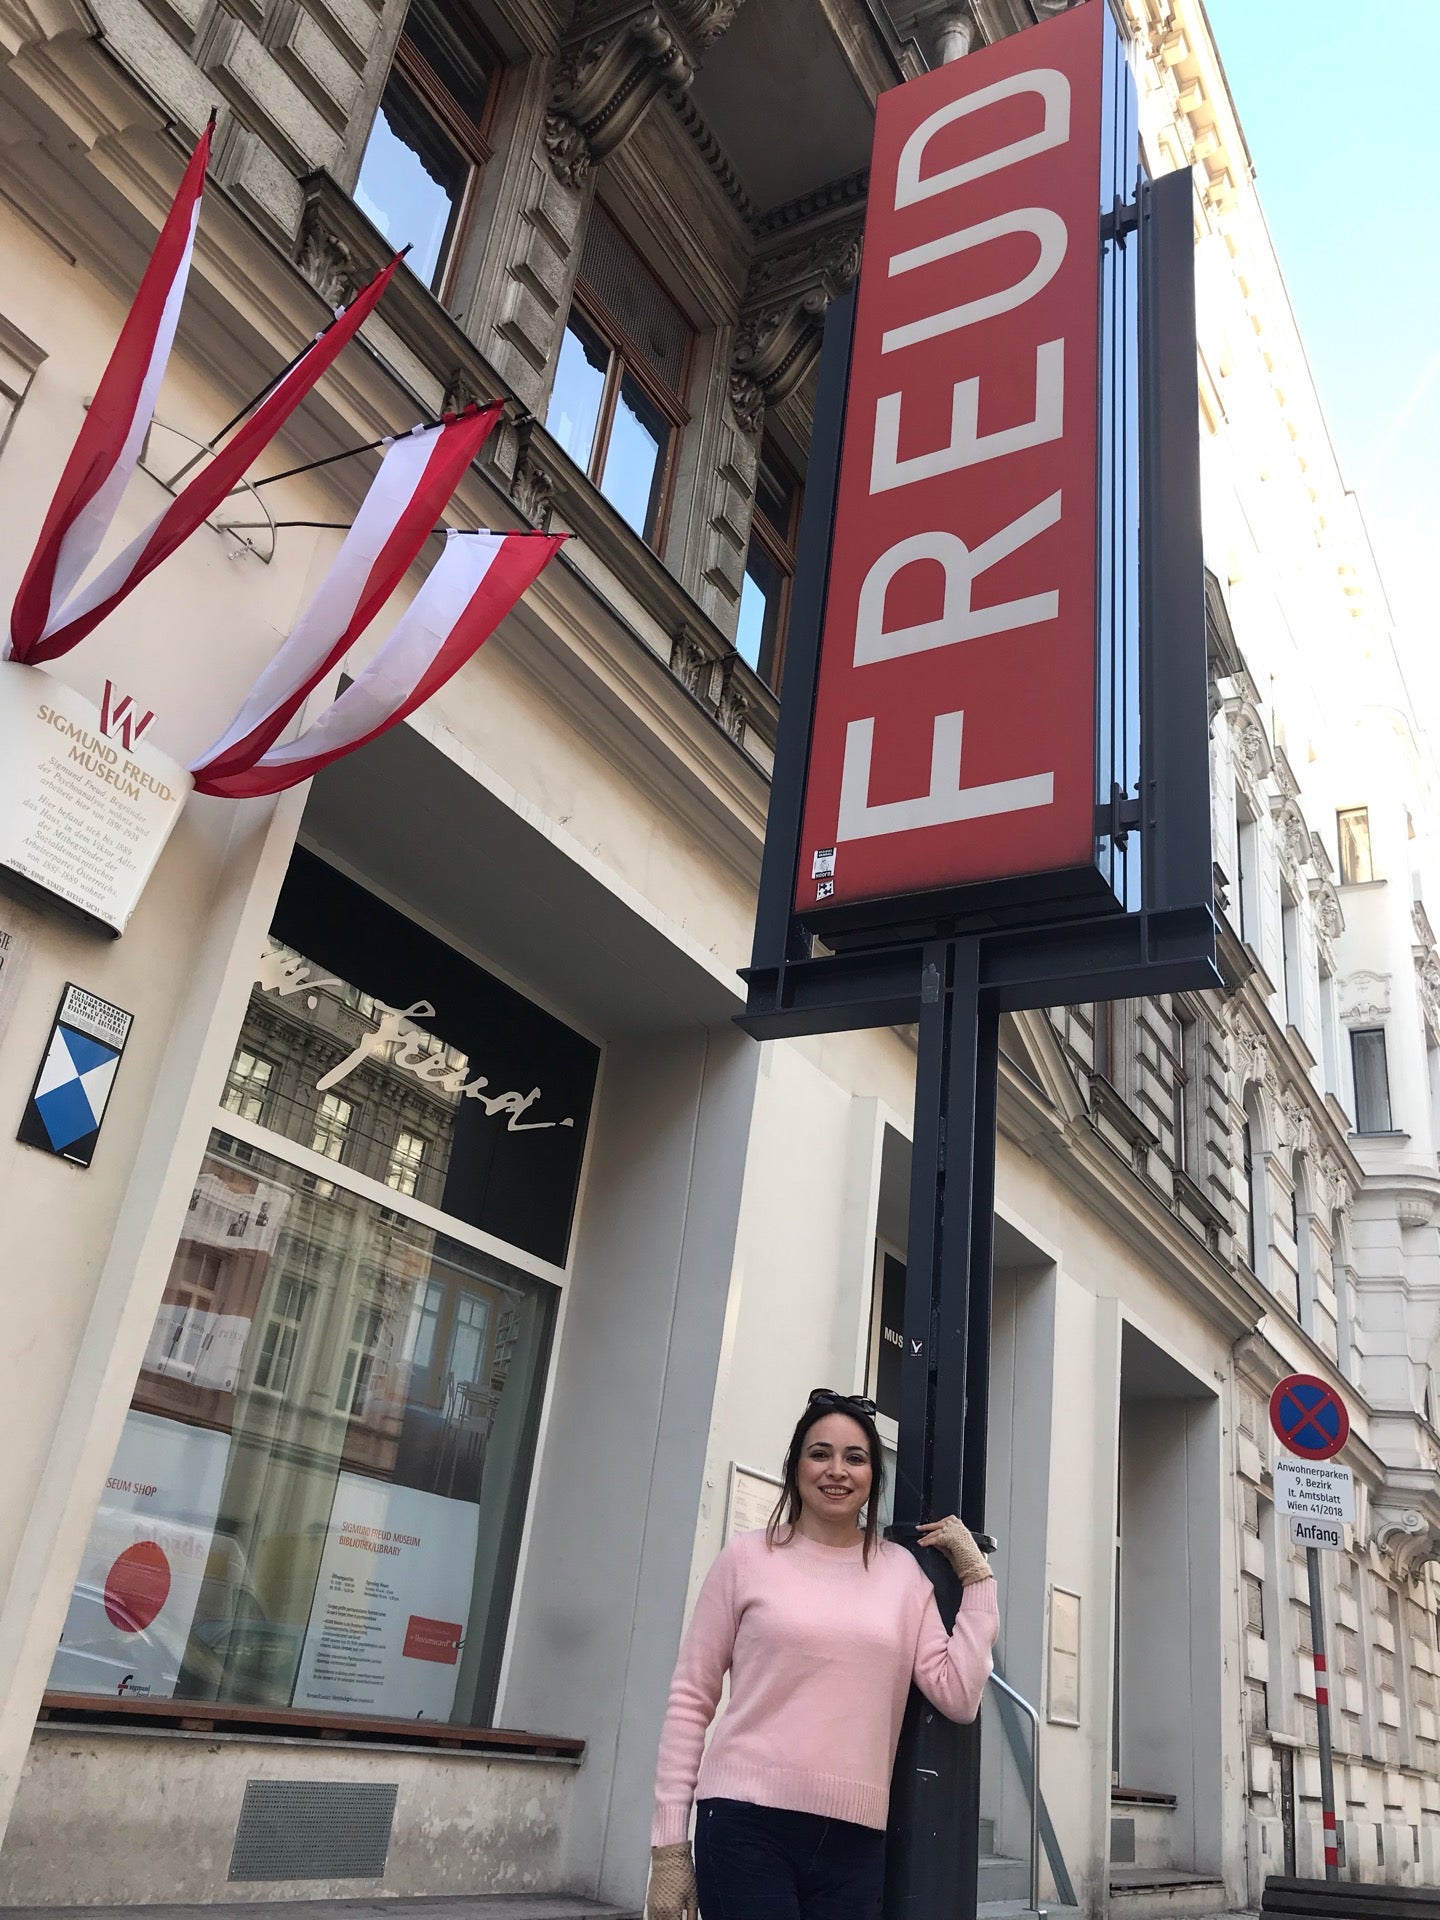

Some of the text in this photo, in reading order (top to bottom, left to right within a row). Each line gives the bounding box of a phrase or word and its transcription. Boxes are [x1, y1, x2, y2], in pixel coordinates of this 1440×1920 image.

[836, 68, 1071, 843] FREUD
[37, 704, 177, 802] SIGMUND FREUD-
[48, 756, 84, 782] Sigmund
[68, 746, 140, 801] MUSEUM
[38, 763, 51, 775] der
[135, 825, 151, 837] und
[40, 777, 74, 801] arbeitete
[75, 798, 90, 811] hier
[92, 810, 104, 821] von
[22, 799, 37, 812] das
[64, 823, 73, 833] in
[74, 830, 89, 844] dem
[92, 839, 115, 858] Viktor
[38, 793, 56, 810] Hier
[57, 806, 84, 827] befand
[86, 825, 101, 838] sich
[102, 834, 113, 846] bis
[22, 837, 74, 871] Arbeiterpartei
[34, 830, 114, 882] Sozialdemokratischen
[38, 820, 118, 872] der Mitbegründer der
[27, 852, 40, 864] von
[80, 883, 105, 901] wohnte
[71, 993, 98, 1011] CULTURAL
[98, 1007, 127, 1025] PROPERTY
[72, 988, 128, 1021] KULTURDENKMAL
[90, 1009, 125, 1031] CULTUREL
[105, 1477, 158, 1497] SEUM SHOP
[1277, 1461, 1349, 1481] Anwohnerparken
[1295, 1476, 1332, 1490] 9. Bezirk
[1287, 1500, 1343, 1517] Wien 41/2018
[1299, 1490, 1341, 1504] Amtsblatt
[338, 1535, 402, 1557] BIBLIOTHEK/LIBRARY
[341, 1521, 421, 1547] SIGMUND FREUD MUSEUM
[1296, 1523, 1338, 1546] Anfang
